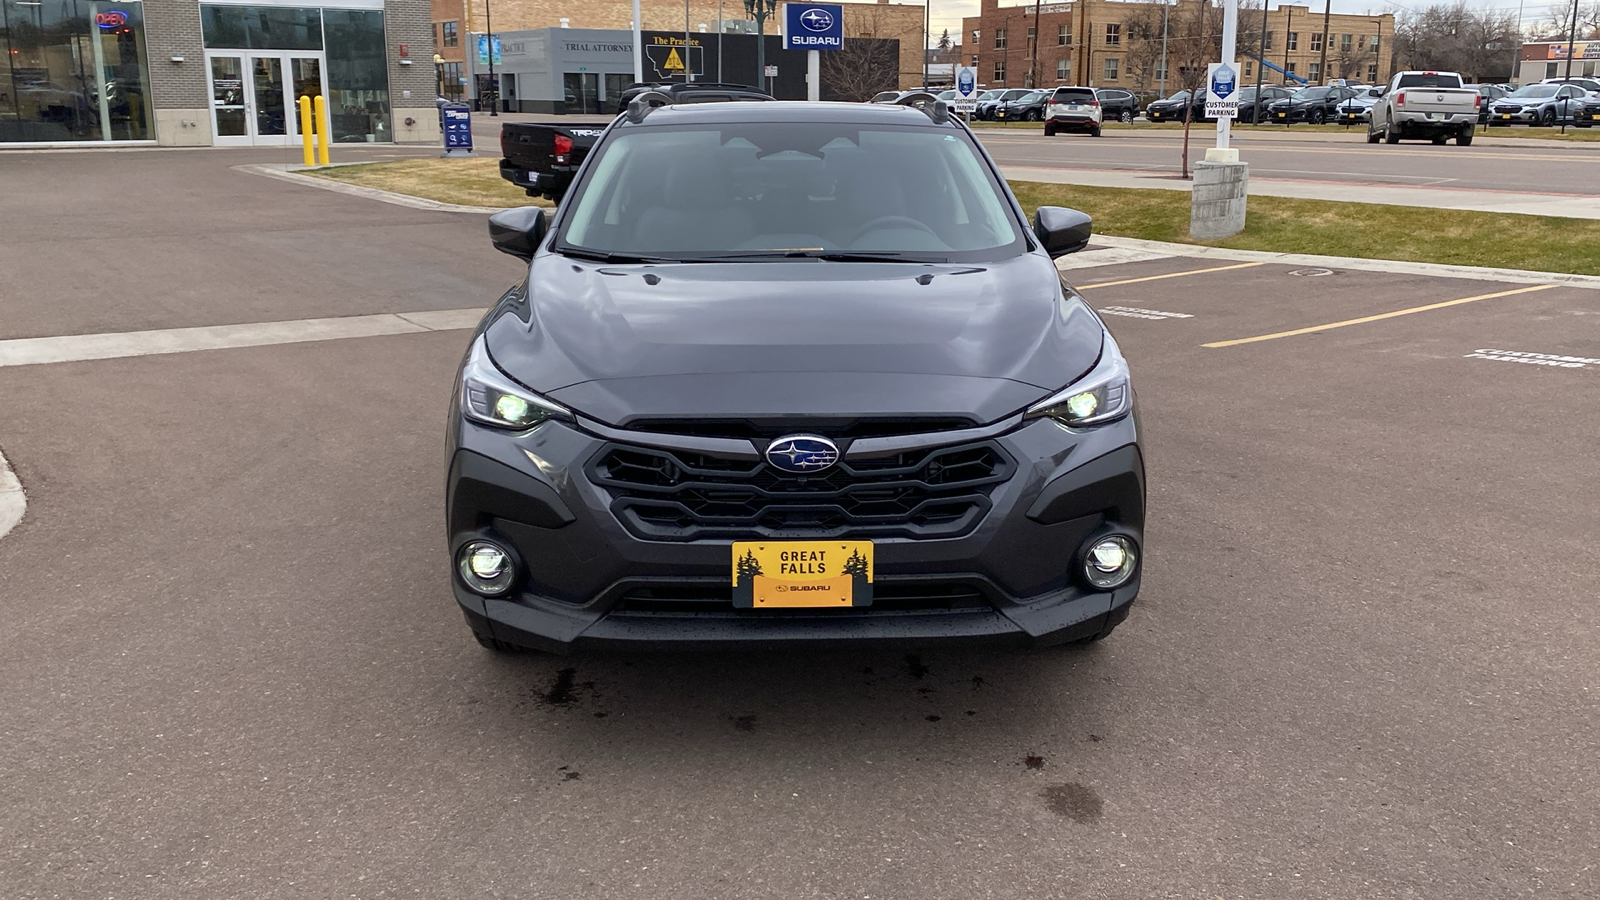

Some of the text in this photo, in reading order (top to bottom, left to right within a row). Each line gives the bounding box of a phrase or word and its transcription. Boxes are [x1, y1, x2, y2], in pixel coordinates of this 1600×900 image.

[95, 13, 124, 25] OPEN
[653, 37, 699, 45] The Pracice
[792, 36, 840, 45] SUBARU
[565, 43, 590, 52] TRIAL
[780, 551, 826, 561] GREAT
[780, 563, 826, 574] FALLS
